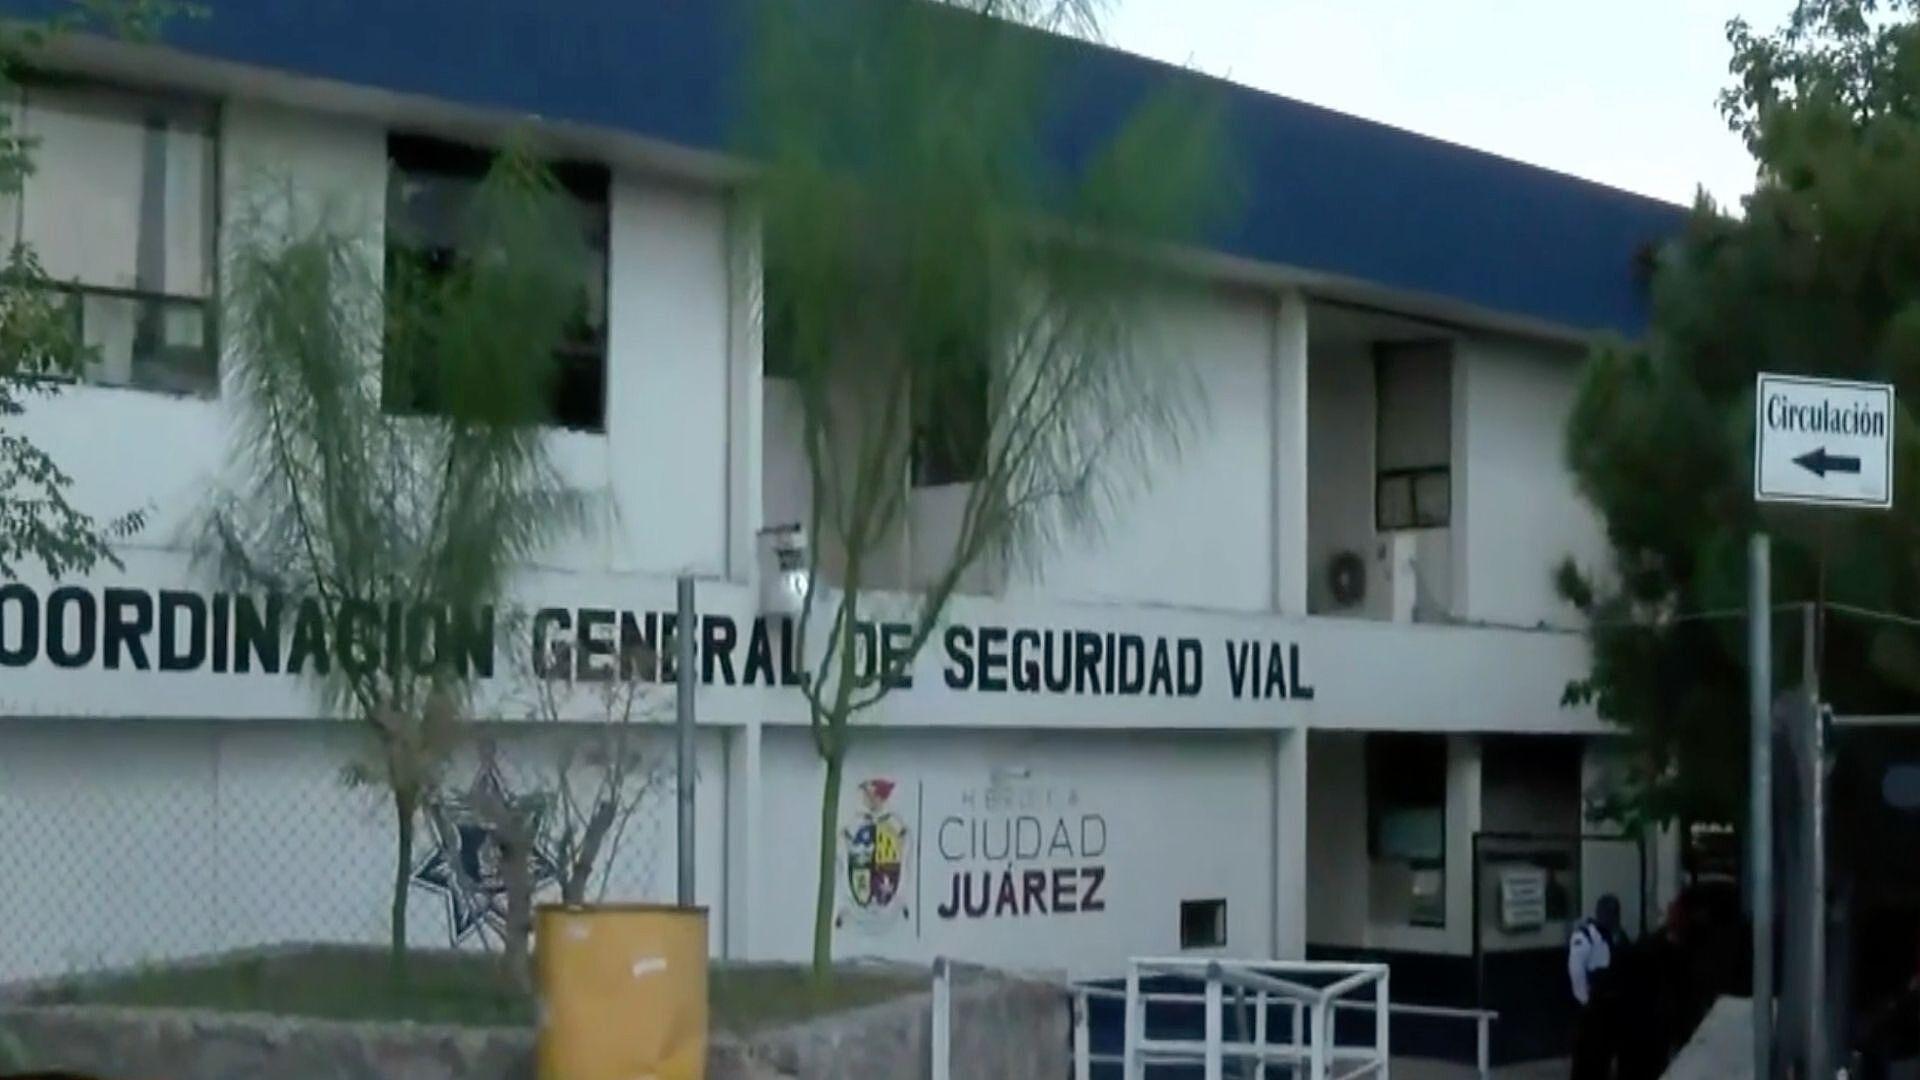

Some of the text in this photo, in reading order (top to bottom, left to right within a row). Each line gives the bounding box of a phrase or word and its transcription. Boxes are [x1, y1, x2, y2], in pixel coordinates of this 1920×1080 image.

[1767, 394, 1885, 438] Circulación
[532, 607, 811, 686] GENERAL
[846, 621, 913, 689] DE
[943, 625, 1204, 698] SEGURIDAD
[1226, 640, 1316, 700] VIAL
[938, 813, 1107, 862] CIUDAD
[937, 864, 1106, 919] JUÁREZ
